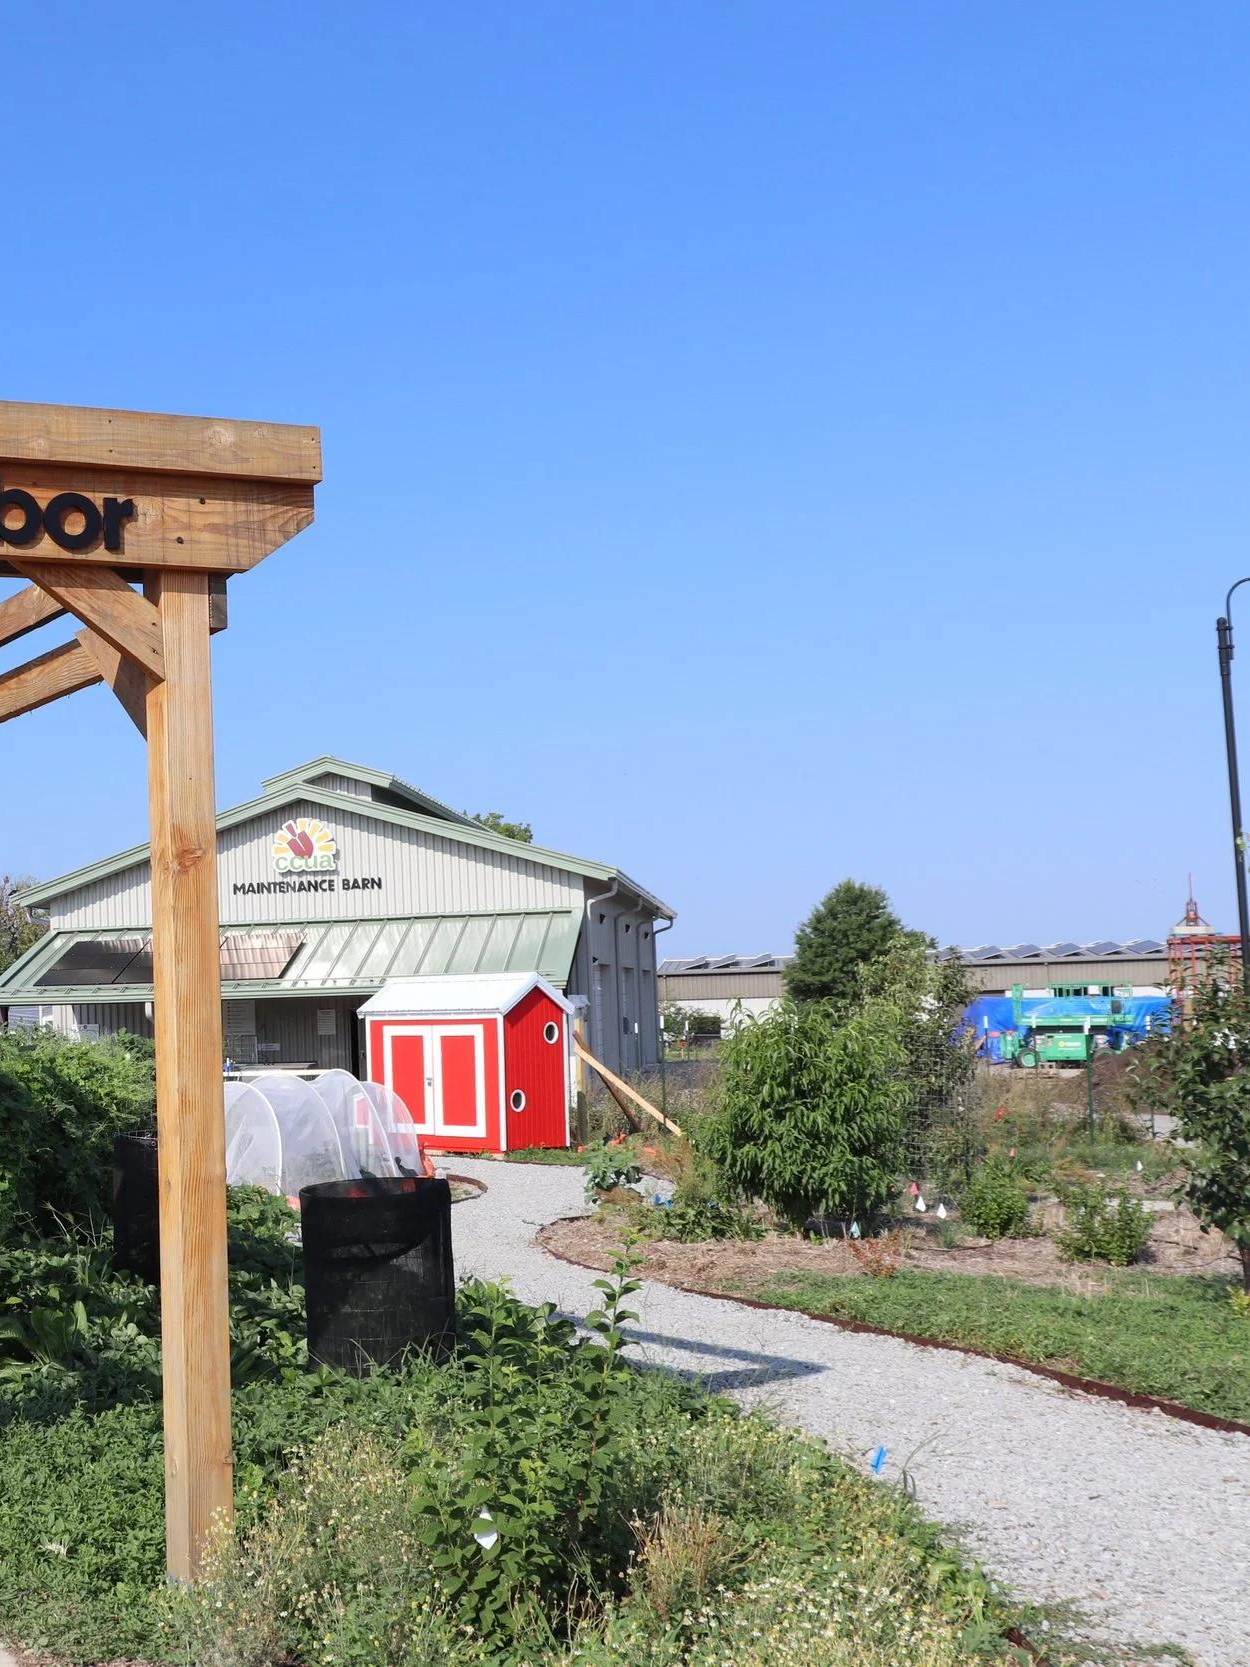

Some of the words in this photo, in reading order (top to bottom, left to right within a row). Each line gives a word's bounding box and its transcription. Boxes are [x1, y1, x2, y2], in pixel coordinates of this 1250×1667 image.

[275, 854, 334, 871] ccua
[233, 879, 335, 895] MAINTENANCE
[342, 878, 383, 891] BARN
